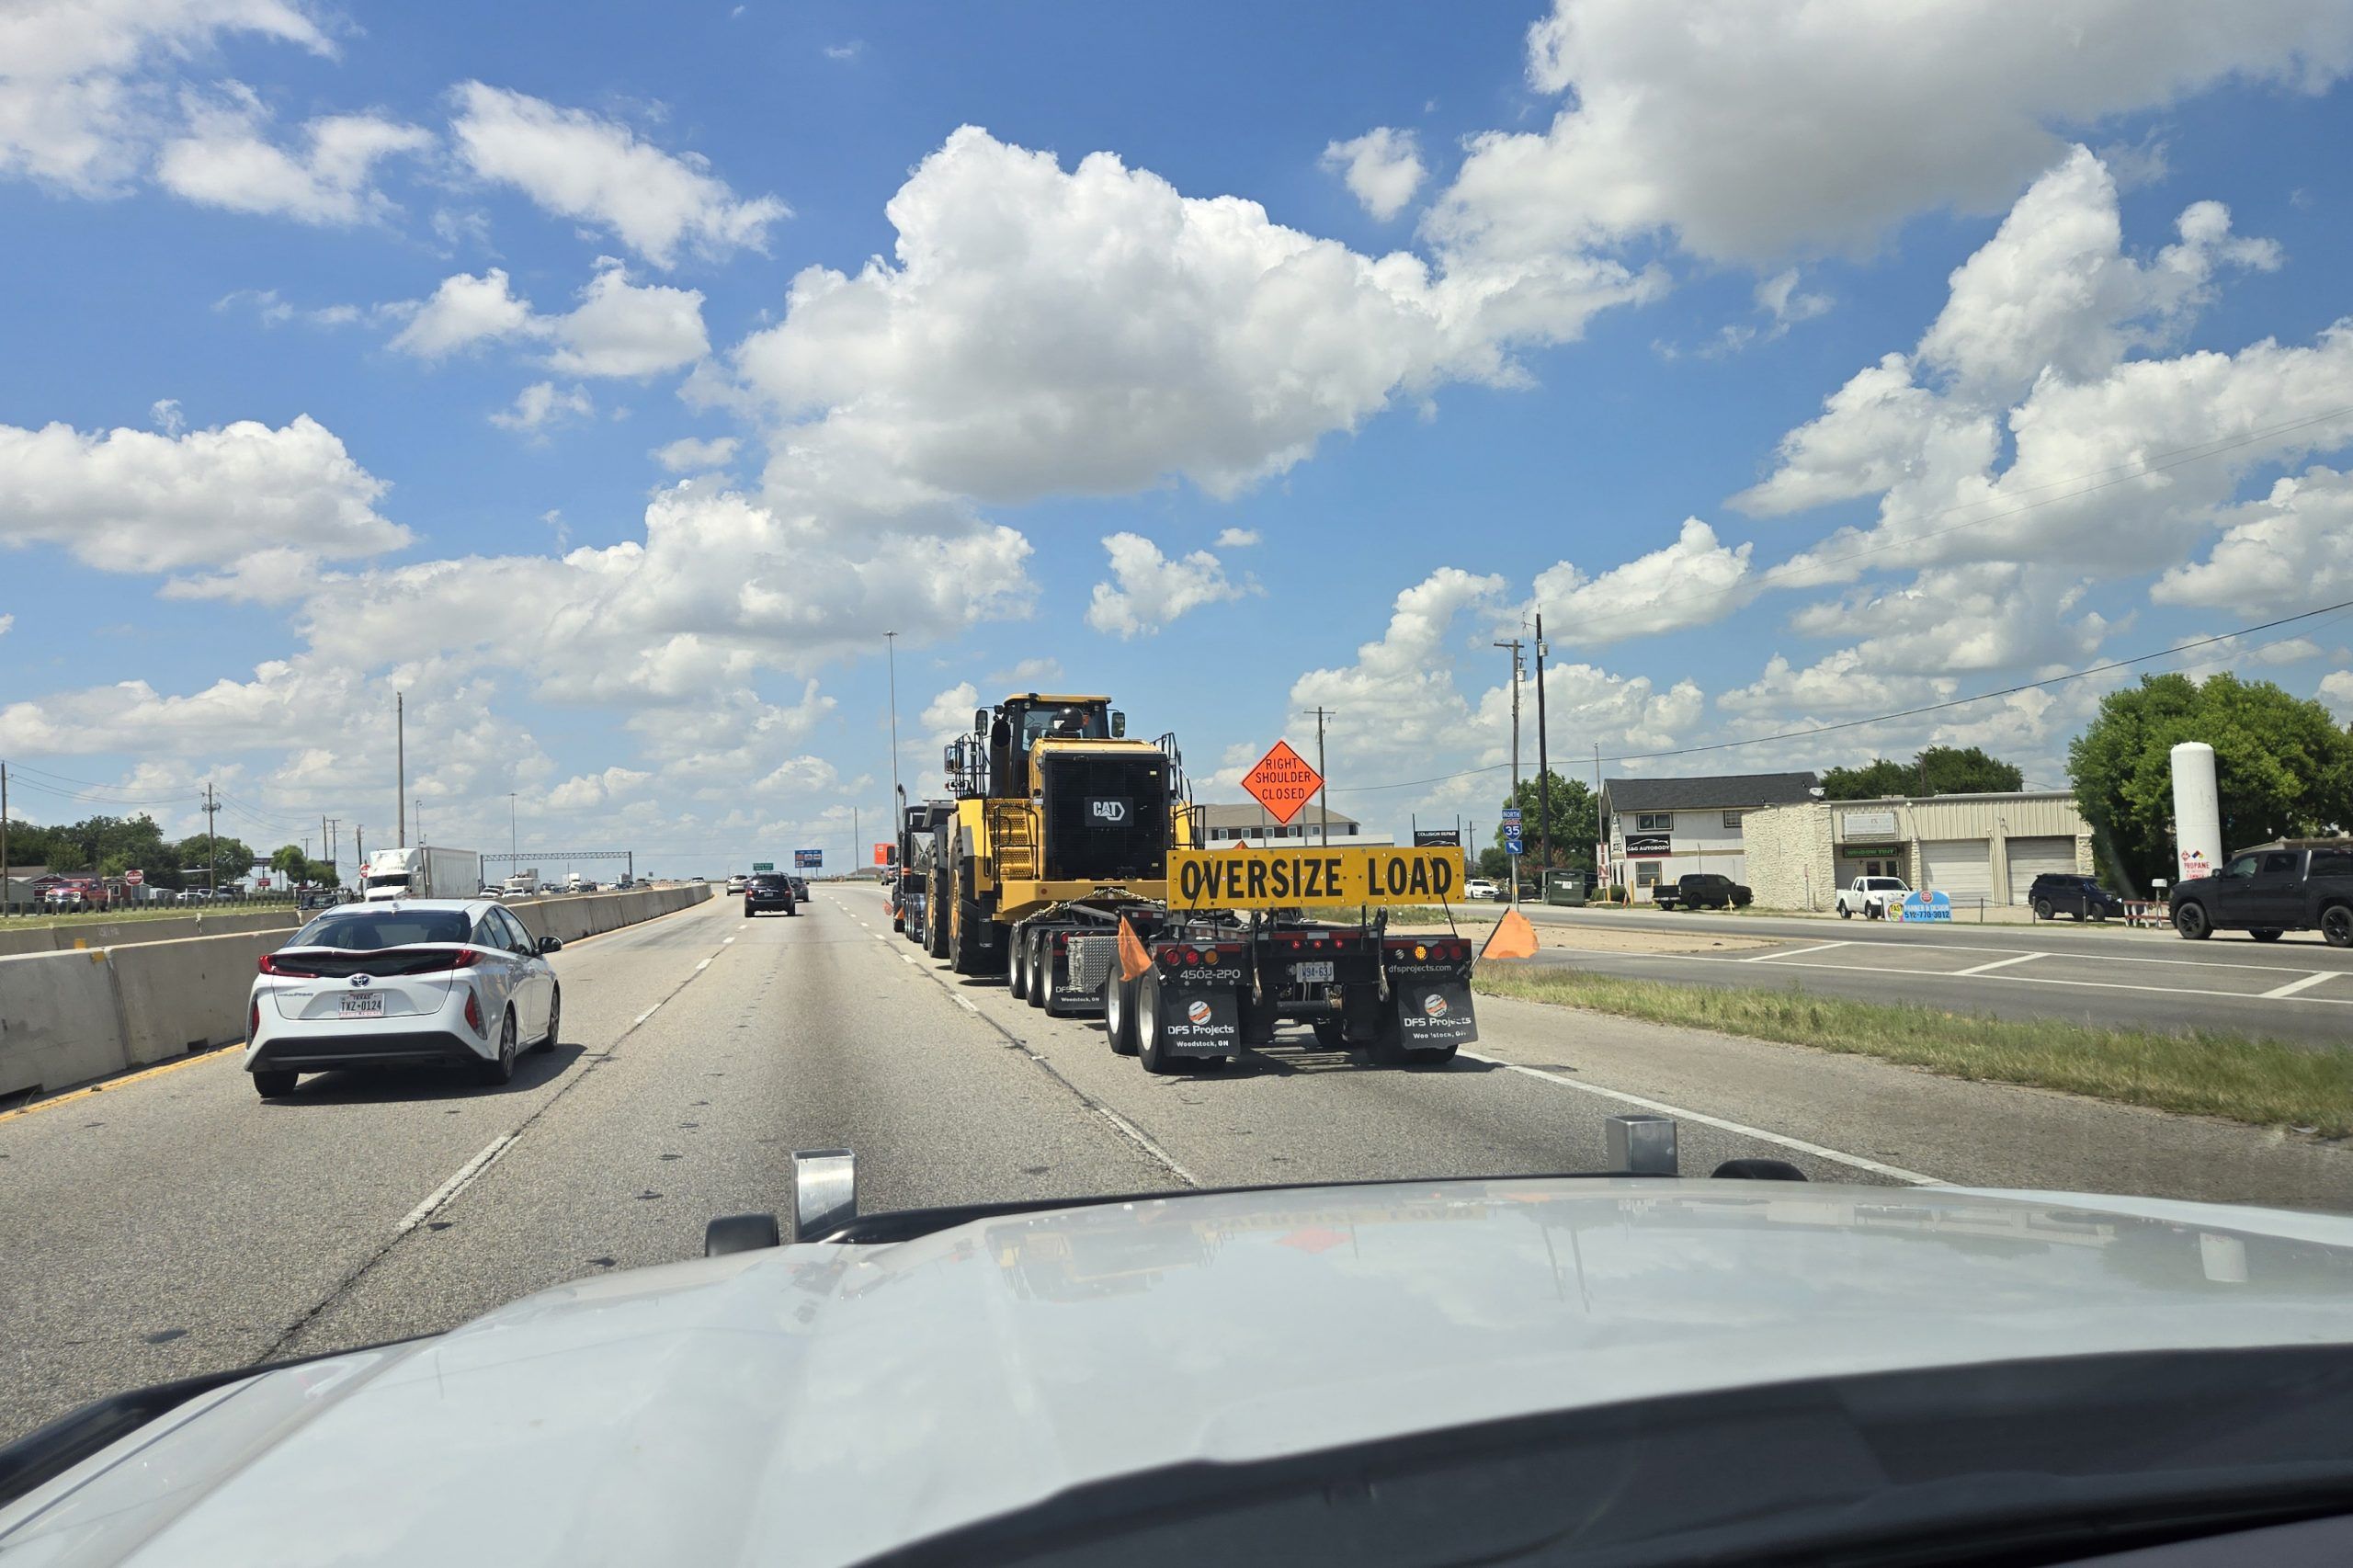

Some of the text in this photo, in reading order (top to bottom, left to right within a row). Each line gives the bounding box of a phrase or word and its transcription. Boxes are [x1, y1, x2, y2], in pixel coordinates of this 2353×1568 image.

[1266, 758, 1297, 769] RIGHT
[1256, 771, 1311, 783] SHOULDER
[1262, 788, 1305, 800] CLOSED
[1093, 801, 1122, 818] CAT
[1506, 825, 1520, 835] 35
[1180, 857, 1452, 900] OVERSIZE LOAD
[1388, 964, 1451, 973] dfsprojects.com
[1404, 1017, 1427, 1027] DFS
[1167, 1025, 1234, 1036] DFS Projects
